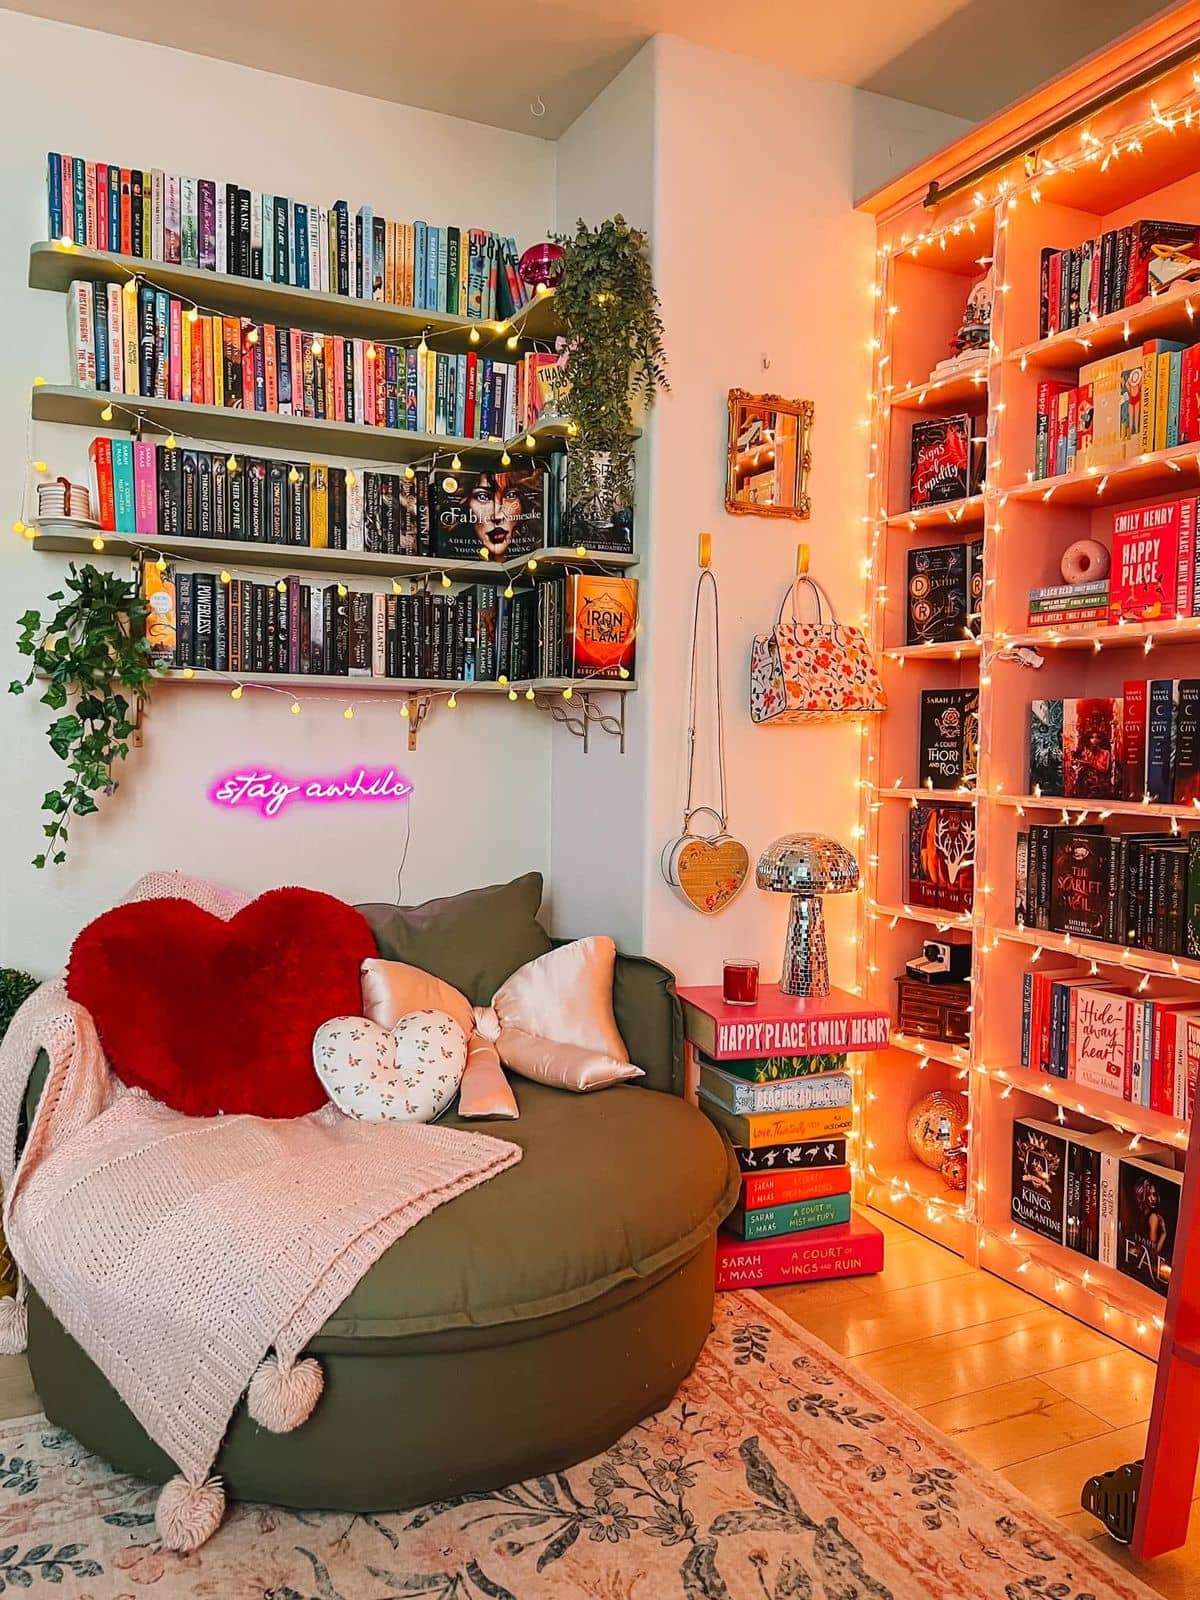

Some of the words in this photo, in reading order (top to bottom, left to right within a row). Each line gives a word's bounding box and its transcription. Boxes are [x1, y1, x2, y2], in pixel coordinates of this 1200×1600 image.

[240, 198, 249, 233] PRAISE
[449, 239, 458, 278] ECSTASY
[79, 288, 87, 315] KRISTAN
[80, 317, 89, 343] HIGGINS
[78, 348, 86, 361] THE
[88, 351, 96, 368] PACK
[79, 363, 88, 381] MOON
[1038, 383, 1049, 414] Happy
[1038, 416, 1048, 441] Place
[918, 444, 945, 464] Signs
[201, 474, 209, 502] THRONE
[917, 462, 959, 493] Cupidity
[232, 481, 240, 499] HEIR
[232, 513, 240, 529] FIRE
[252, 507, 260, 536] SHADOWS
[273, 516, 281, 537] DAWN
[420, 505, 429, 542] SAINT
[1114, 512, 1140, 533] EMILY
[1143, 506, 1174, 528] HENRY
[1181, 504, 1190, 529] HAPPY
[448, 537, 485, 545] ADRIENN
[1122, 538, 1160, 565] HAPPY
[1179, 530, 1190, 554] PLACE
[1121, 561, 1158, 587] PLACE
[1178, 559, 1188, 582] EMILY
[1177, 585, 1187, 609] HENRY
[196, 585, 212, 634] POWERLESS
[586, 610, 623, 626] IRON
[376, 612, 384, 654] GALLANT
[583, 629, 625, 644] FLAME
[927, 696, 949, 704] SARAH
[927, 748, 959, 762] THOR
[215, 773, 300, 815] stay
[305, 770, 412, 797] awhile
[1072, 867, 1088, 877] THE
[1057, 875, 1102, 895] SCARLET
[1066, 896, 1091, 912] VEIL
[1080, 1000, 1124, 1025] Hide
[719, 1022, 764, 1052] HAPPY
[765, 1022, 806, 1050] PLACE
[810, 1020, 848, 1046] EMILY
[850, 1017, 891, 1045] HENRY
[1082, 1024, 1120, 1042] away
[1082, 1036, 1123, 1062] heart
[754, 1181, 774, 1191] SARAH
[757, 1193, 774, 1202] MAAS
[1022, 1188, 1052, 1212] KINGS
[751, 1212, 774, 1223] SARAH
[789, 1217, 806, 1227] MIST
[816, 1212, 836, 1222] FURY
[800, 1204, 824, 1215] COURT
[1012, 1196, 1062, 1233] QUARANTINE
[755, 1223, 776, 1234] MAAS
[722, 1255, 761, 1268] SARAH
[791, 1252, 798, 1261] A
[803, 1247, 841, 1259] COURT
[729, 1269, 763, 1280] MAAS
[781, 1263, 818, 1275] WINGS
[835, 1259, 861, 1271] RUIN
